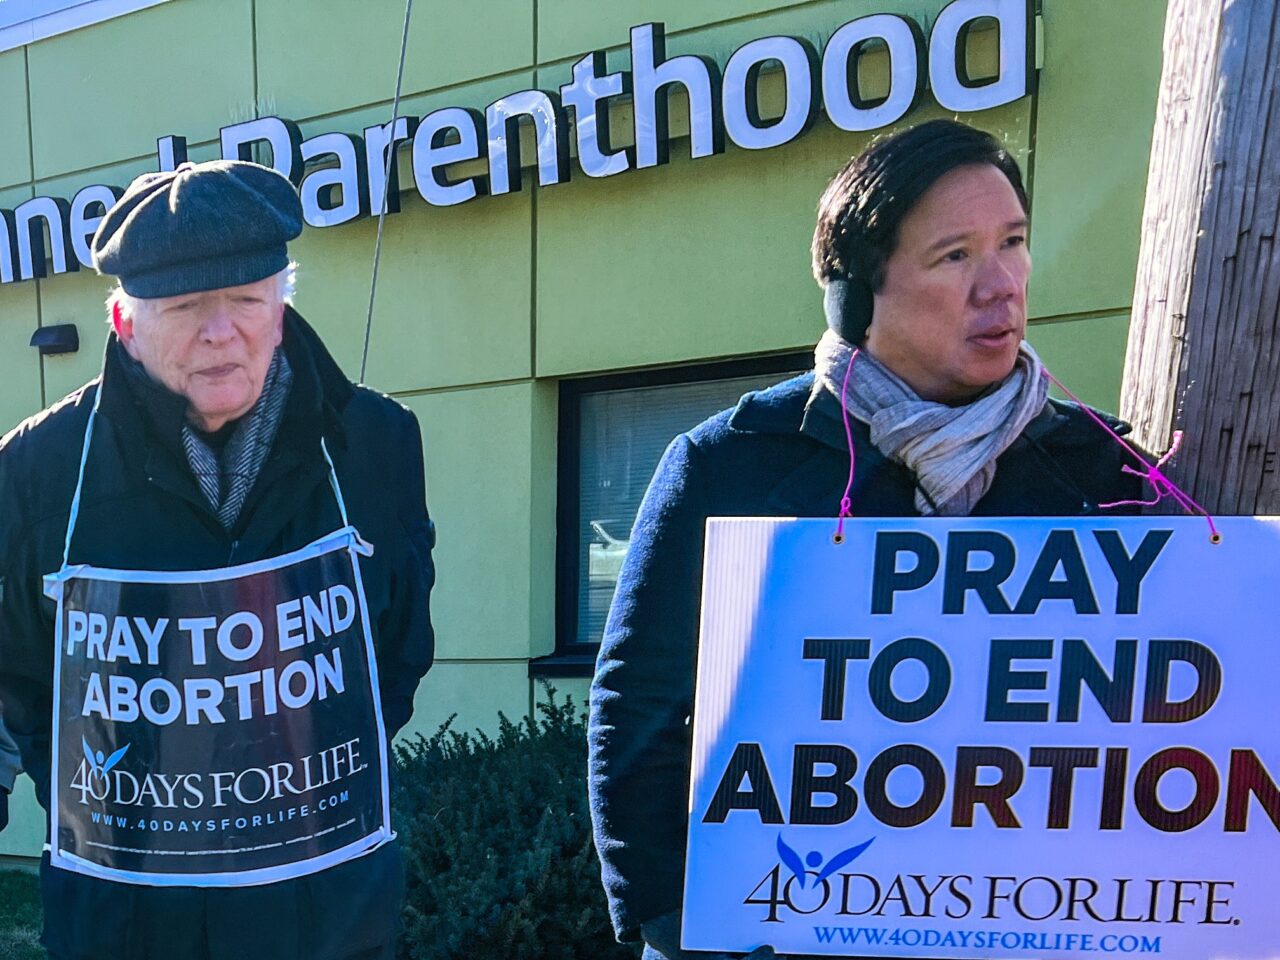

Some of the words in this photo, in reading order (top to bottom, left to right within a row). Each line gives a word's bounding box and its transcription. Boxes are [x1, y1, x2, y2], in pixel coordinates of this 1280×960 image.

[220, 0, 1028, 228] Parenthood
[870, 529, 1175, 616] PRAY
[67, 610, 170, 665] PRAY
[178, 611, 264, 665] TO
[276, 584, 356, 651] END
[82, 648, 346, 725] ABORTION
[803, 637, 952, 723] TO
[984, 638, 1223, 724] END
[70, 757, 111, 804] 40
[113, 769, 204, 809] DAYS
[91, 790, 350, 832] WWW.40DAYSFORLIFE.COM
[702, 743, 1280, 833] ABORTION
[743, 862, 831, 923] 40
[835, 873, 973, 919] DAYS
[814, 926, 1162, 953] WWW.40DAYSFORLIFE.COM
